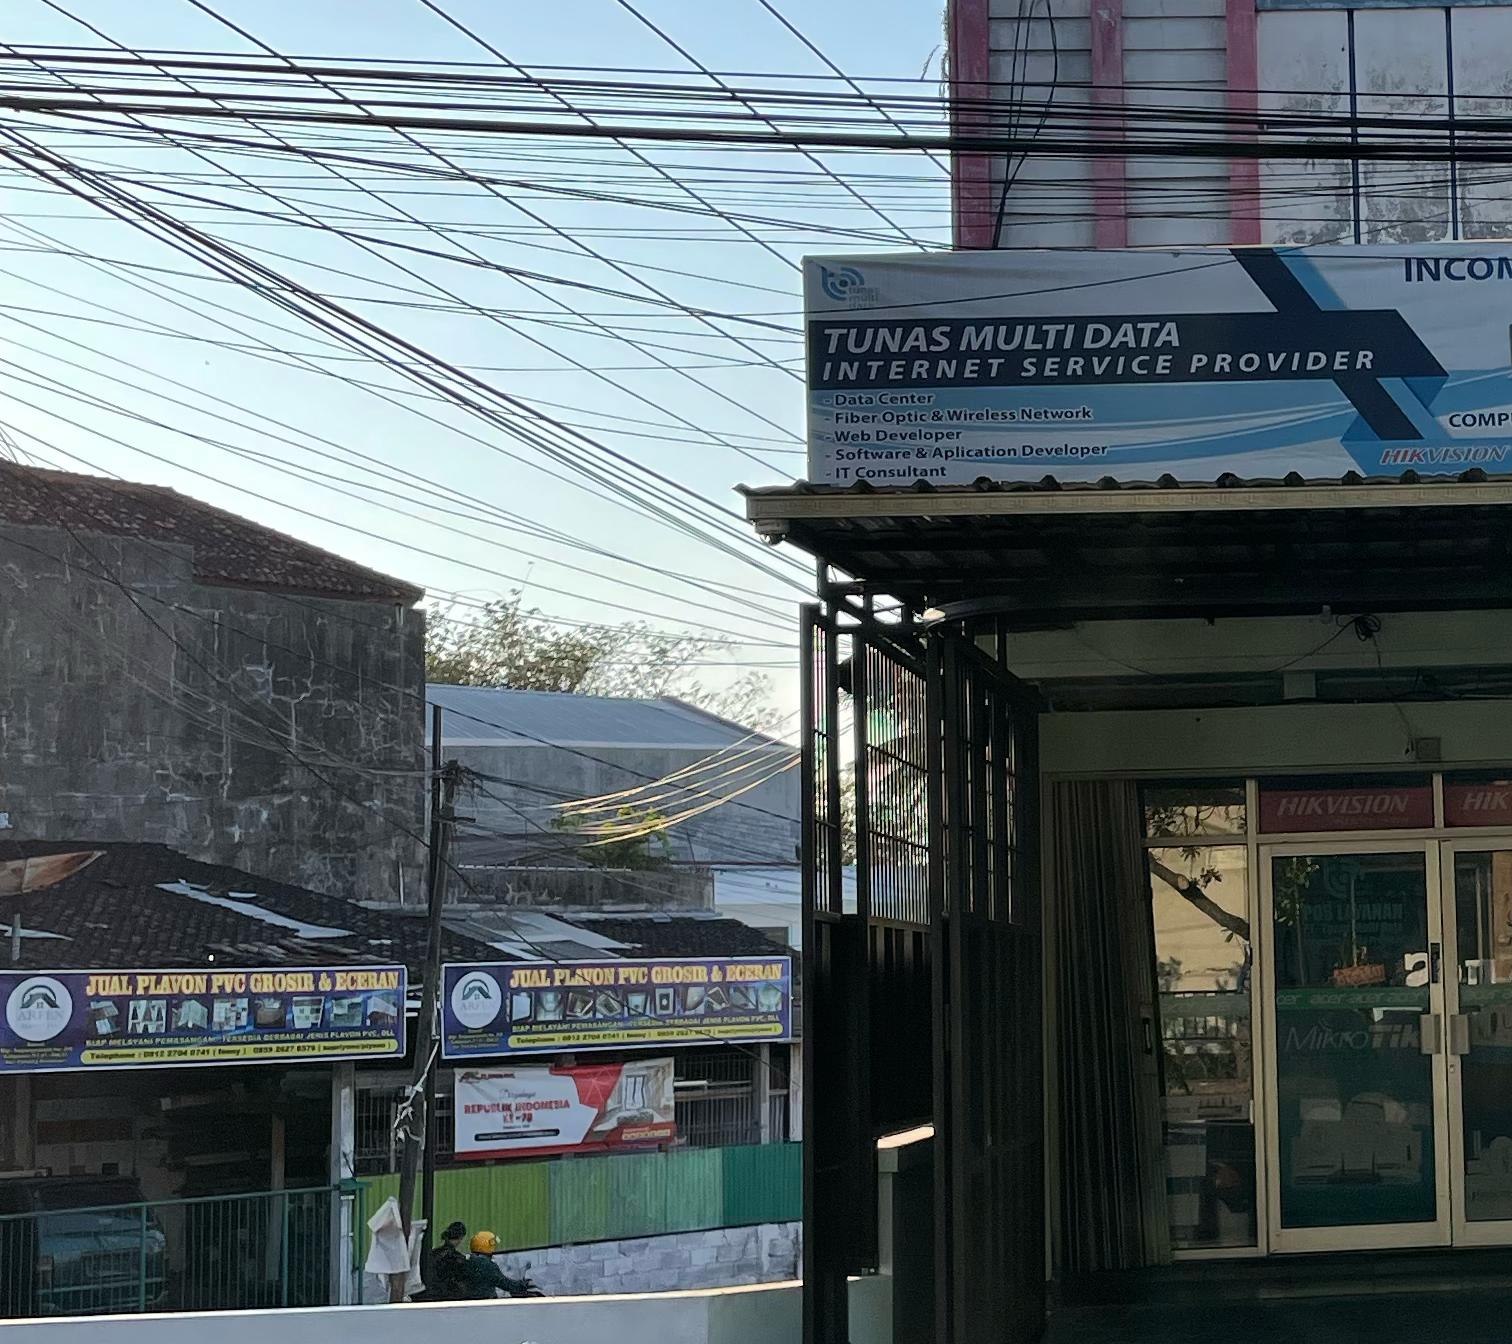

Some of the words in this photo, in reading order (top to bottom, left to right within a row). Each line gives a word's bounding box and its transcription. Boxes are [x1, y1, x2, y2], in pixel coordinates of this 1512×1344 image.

[824, 325, 952, 354] TUNAS
[959, 323, 1076, 351] MULTI
[1083, 321, 1180, 349] DATA
[822, 358, 1005, 381] INTERNET
[1020, 354, 1173, 378] SERVICE
[1190, 350, 1374, 373] PROVIDER
[835, 393, 875, 406] Data
[879, 393, 934, 405] Center
[835, 411, 878, 424] Fiber
[882, 411, 928, 425] Optic
[931, 411, 944, 422] &
[946, 408, 1017, 422] Wireless
[1020, 407, 1092, 421] Network
[835, 430, 871, 442] Web
[875, 429, 962, 443] Developer
[835, 448, 911, 461] Software
[915, 447, 928, 459] &
[931, 446, 1017, 462] Aplication
[1021, 444, 1108, 459] Developer
[1380, 445, 1511, 465] HIKVISION
[835, 467, 850, 479] IT
[855, 465, 947, 479] Consultant
[1277, 795, 1408, 817] HIKVISION
[86, 975, 133, 996] JUAL
[136, 974, 207, 995] PLAVON
[210, 974, 246, 994] PVC
[250, 972, 315, 993] GROSIR
[318, 972, 332, 991] &
[336, 971, 398, 991] ECERAN
[510, 969, 550, 988] JUAL
[553, 967, 615, 987] PLAVON
[618, 967, 648, 985] PVC
[651, 965, 708, 984] GROSIR
[711, 965, 723, 982] &
[725, 963, 783, 982] ECERAN
[1276, 994, 1297, 1005] cer
[464, 1104, 512, 1114] REPUBLIK
[515, 1099, 570, 1113] INDONESIA
